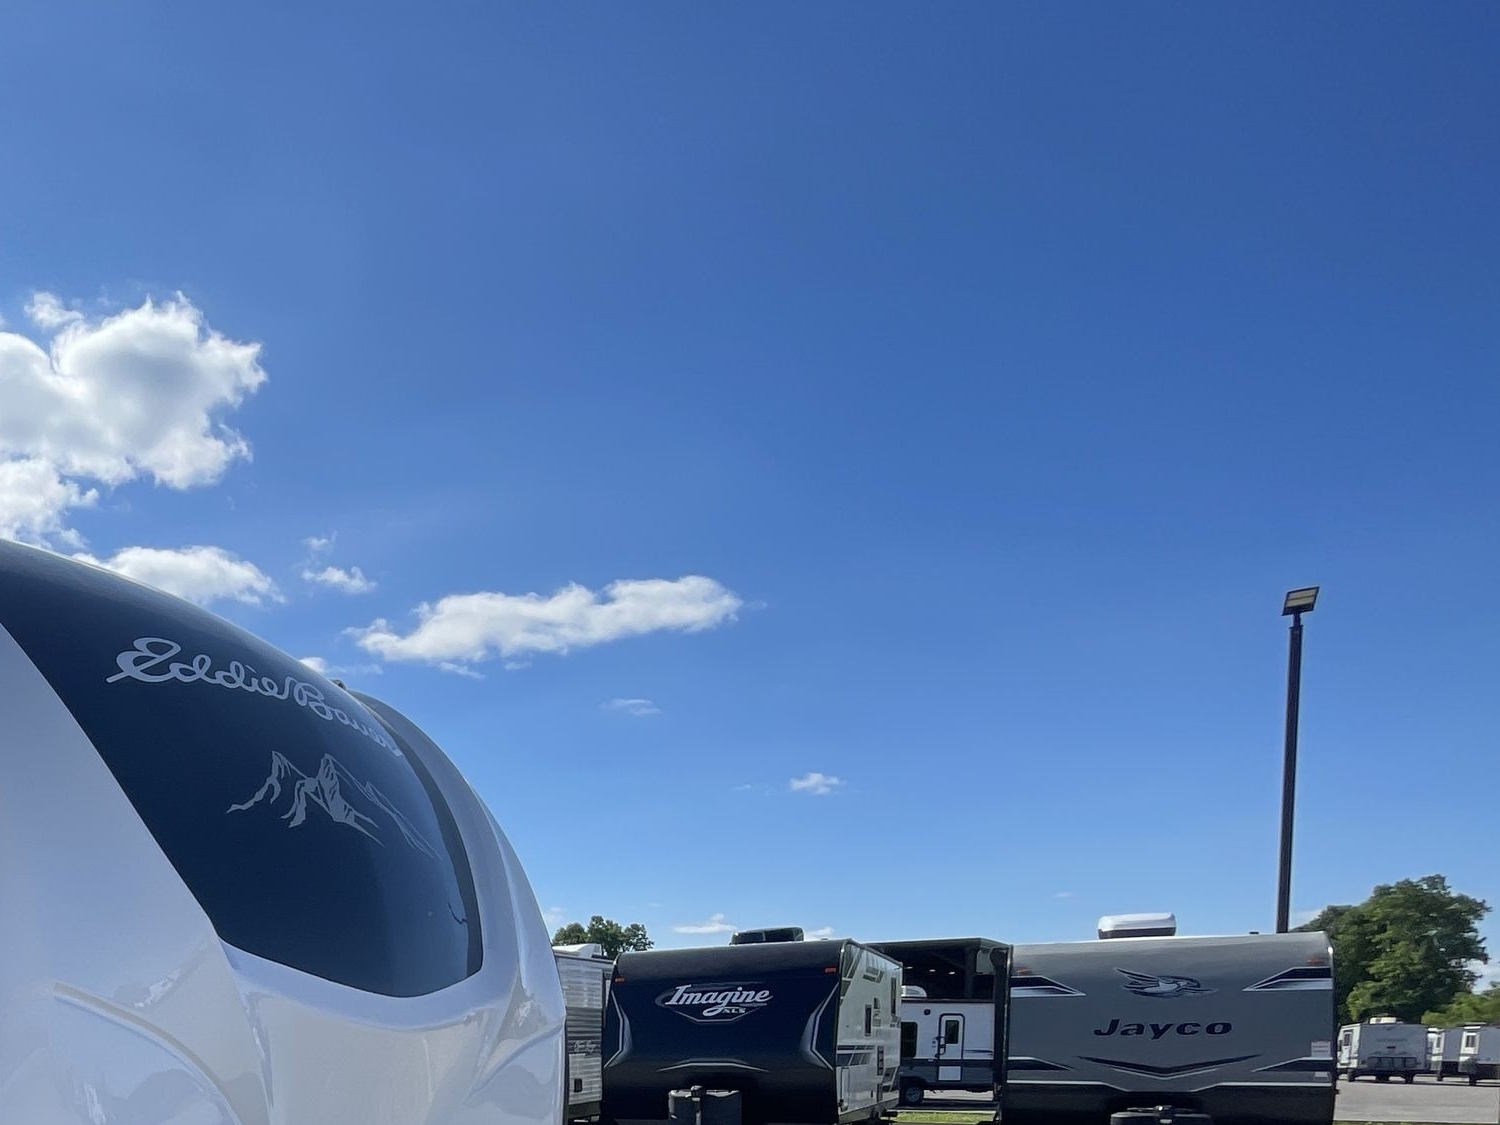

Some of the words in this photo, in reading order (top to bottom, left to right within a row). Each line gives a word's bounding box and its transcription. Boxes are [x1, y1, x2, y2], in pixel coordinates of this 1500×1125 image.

[106, 637, 288, 700] Eddie
[664, 984, 774, 1016] Imagine
[1093, 1018, 1233, 1040] Jayco
